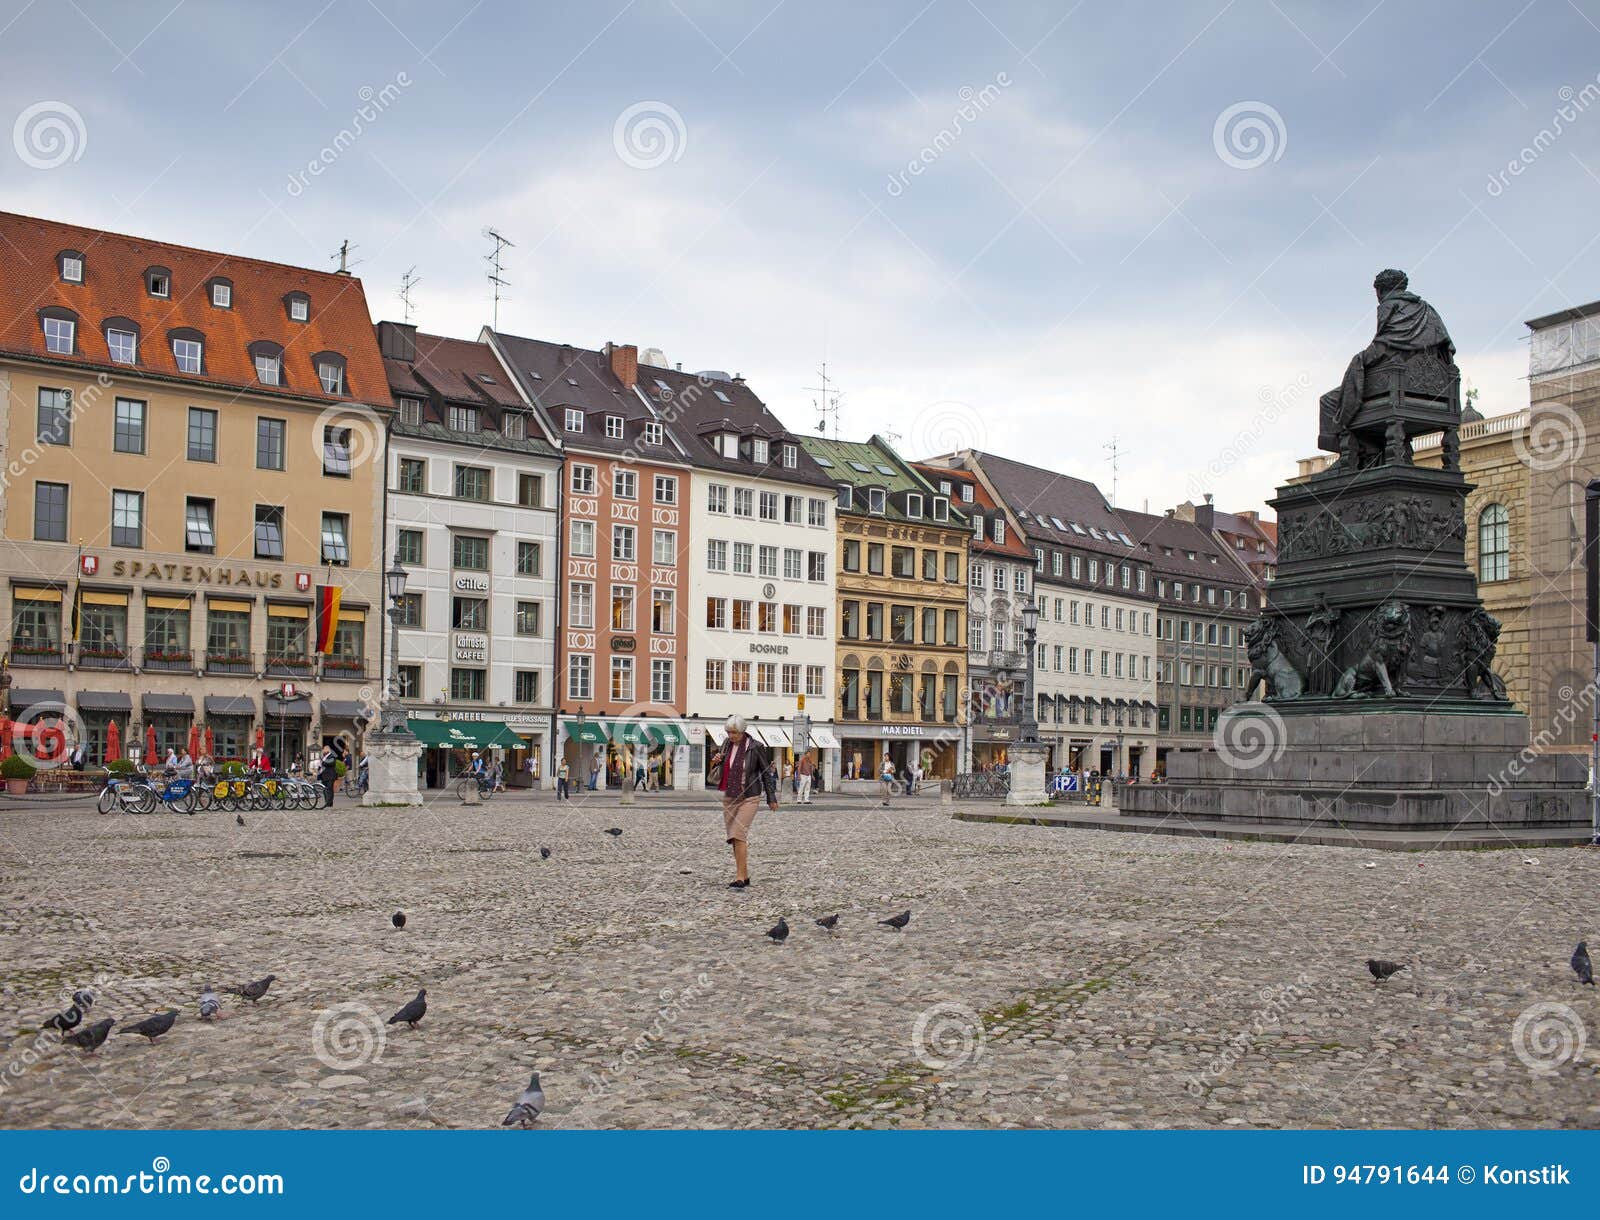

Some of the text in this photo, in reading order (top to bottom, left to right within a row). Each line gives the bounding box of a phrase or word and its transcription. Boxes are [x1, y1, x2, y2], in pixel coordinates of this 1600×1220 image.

[113, 560, 283, 588] SPATENHAUS
[749, 643, 789, 655] BOGNER
[882, 726, 924, 735] MAX DIETL
